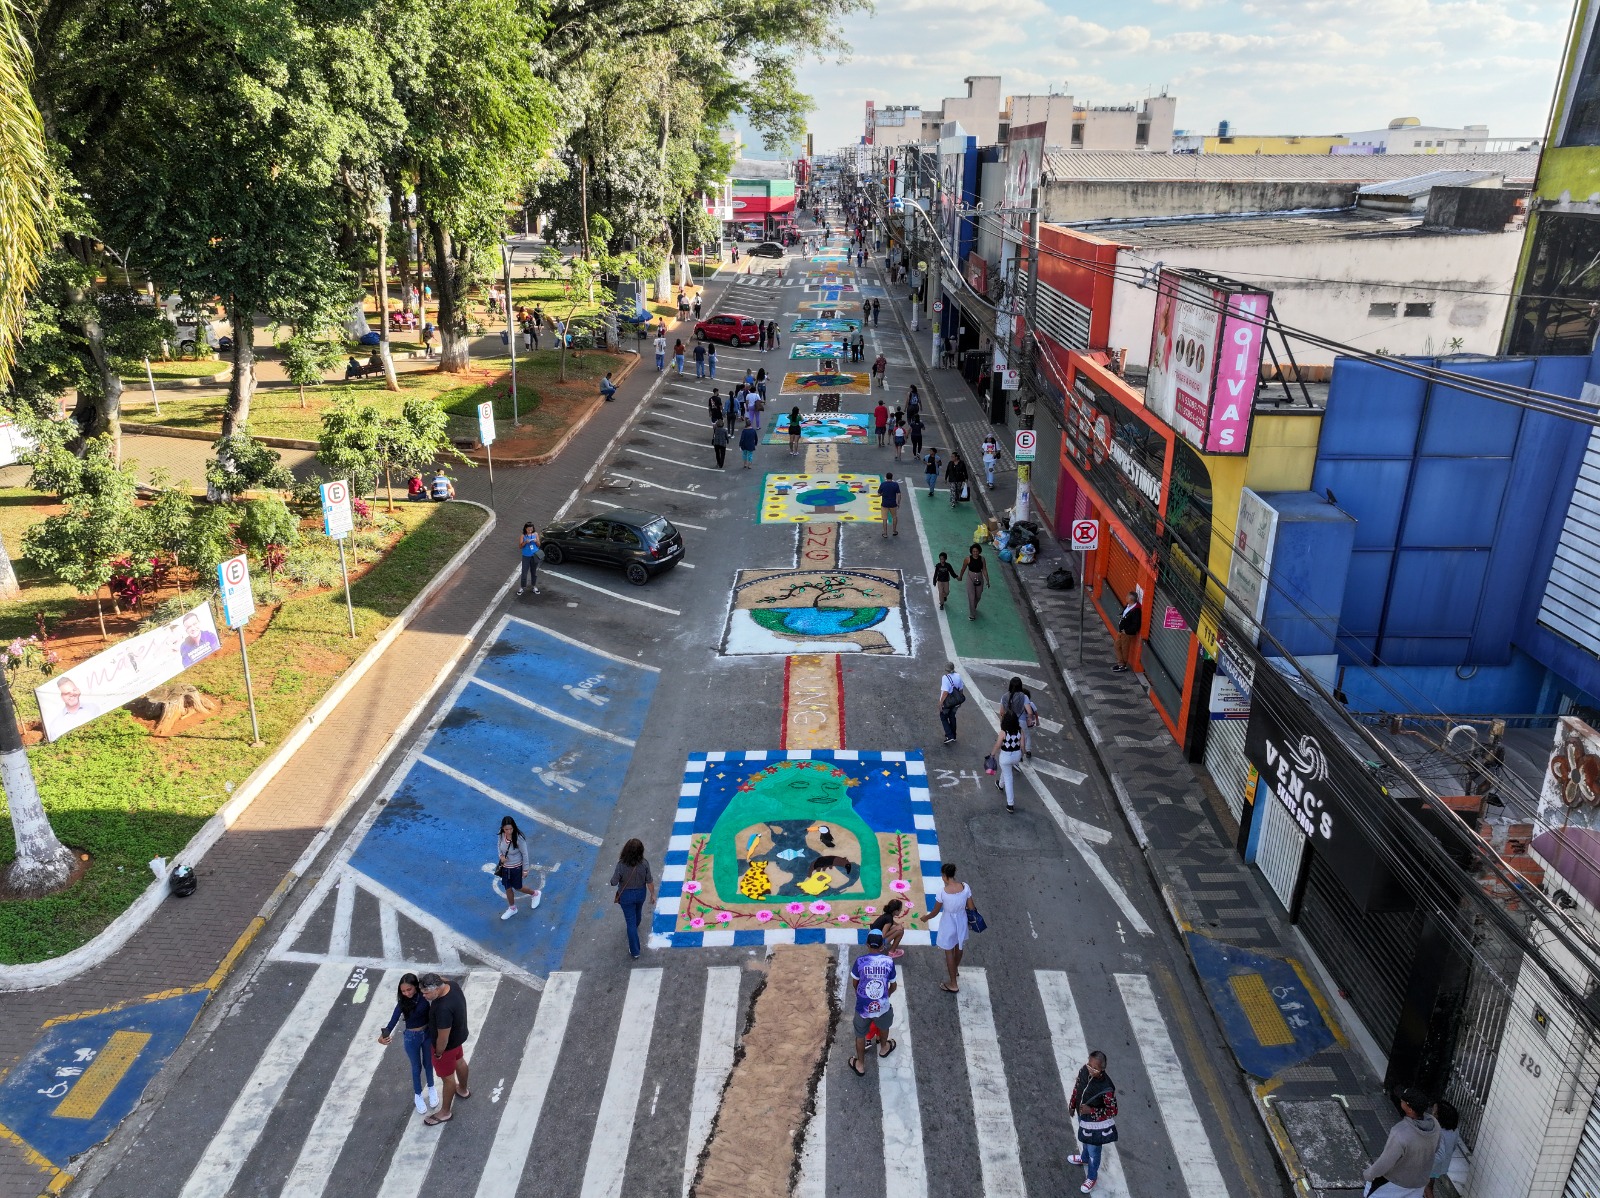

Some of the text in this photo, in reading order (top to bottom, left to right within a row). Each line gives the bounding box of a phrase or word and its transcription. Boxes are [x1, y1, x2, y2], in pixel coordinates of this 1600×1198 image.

[1219, 301, 1256, 445] NOIVAS
[484, 406, 489, 416] E
[1022, 435, 1030, 445] E
[332, 487, 341, 500] E
[231, 564, 240, 580] E
[933, 768, 983, 790] 34
[1265, 739, 1333, 839] VENC'S
[1277, 783, 1315, 837] SKATE SHOP
[1518, 1052, 1542, 1080] 129
